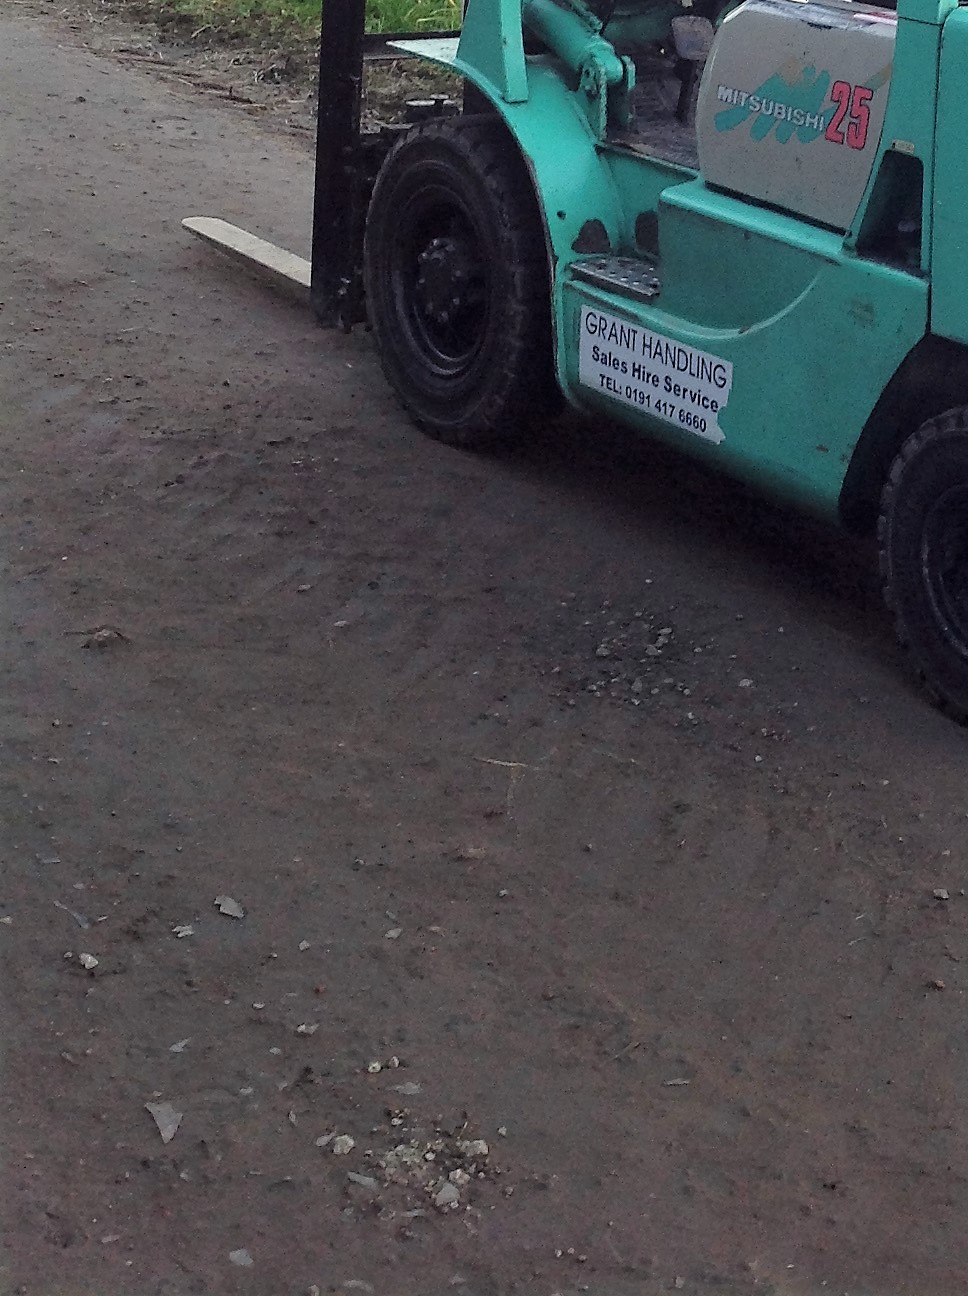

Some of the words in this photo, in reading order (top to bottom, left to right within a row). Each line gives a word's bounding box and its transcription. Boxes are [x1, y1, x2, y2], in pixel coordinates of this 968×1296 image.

[717, 84, 824, 131] MITSUBISHI
[825, 80, 873, 151] 25
[585, 311, 638, 352] GRANT
[642, 332, 727, 389] HANDLING
[591, 345, 628, 374] Sales
[631, 362, 660, 387] Hire
[663, 375, 719, 413] Service
[599, 373, 622, 395] TEL:
[625, 385, 651, 408] 0191
[654, 399, 675, 418] 417
[678, 409, 707, 433] 6660
